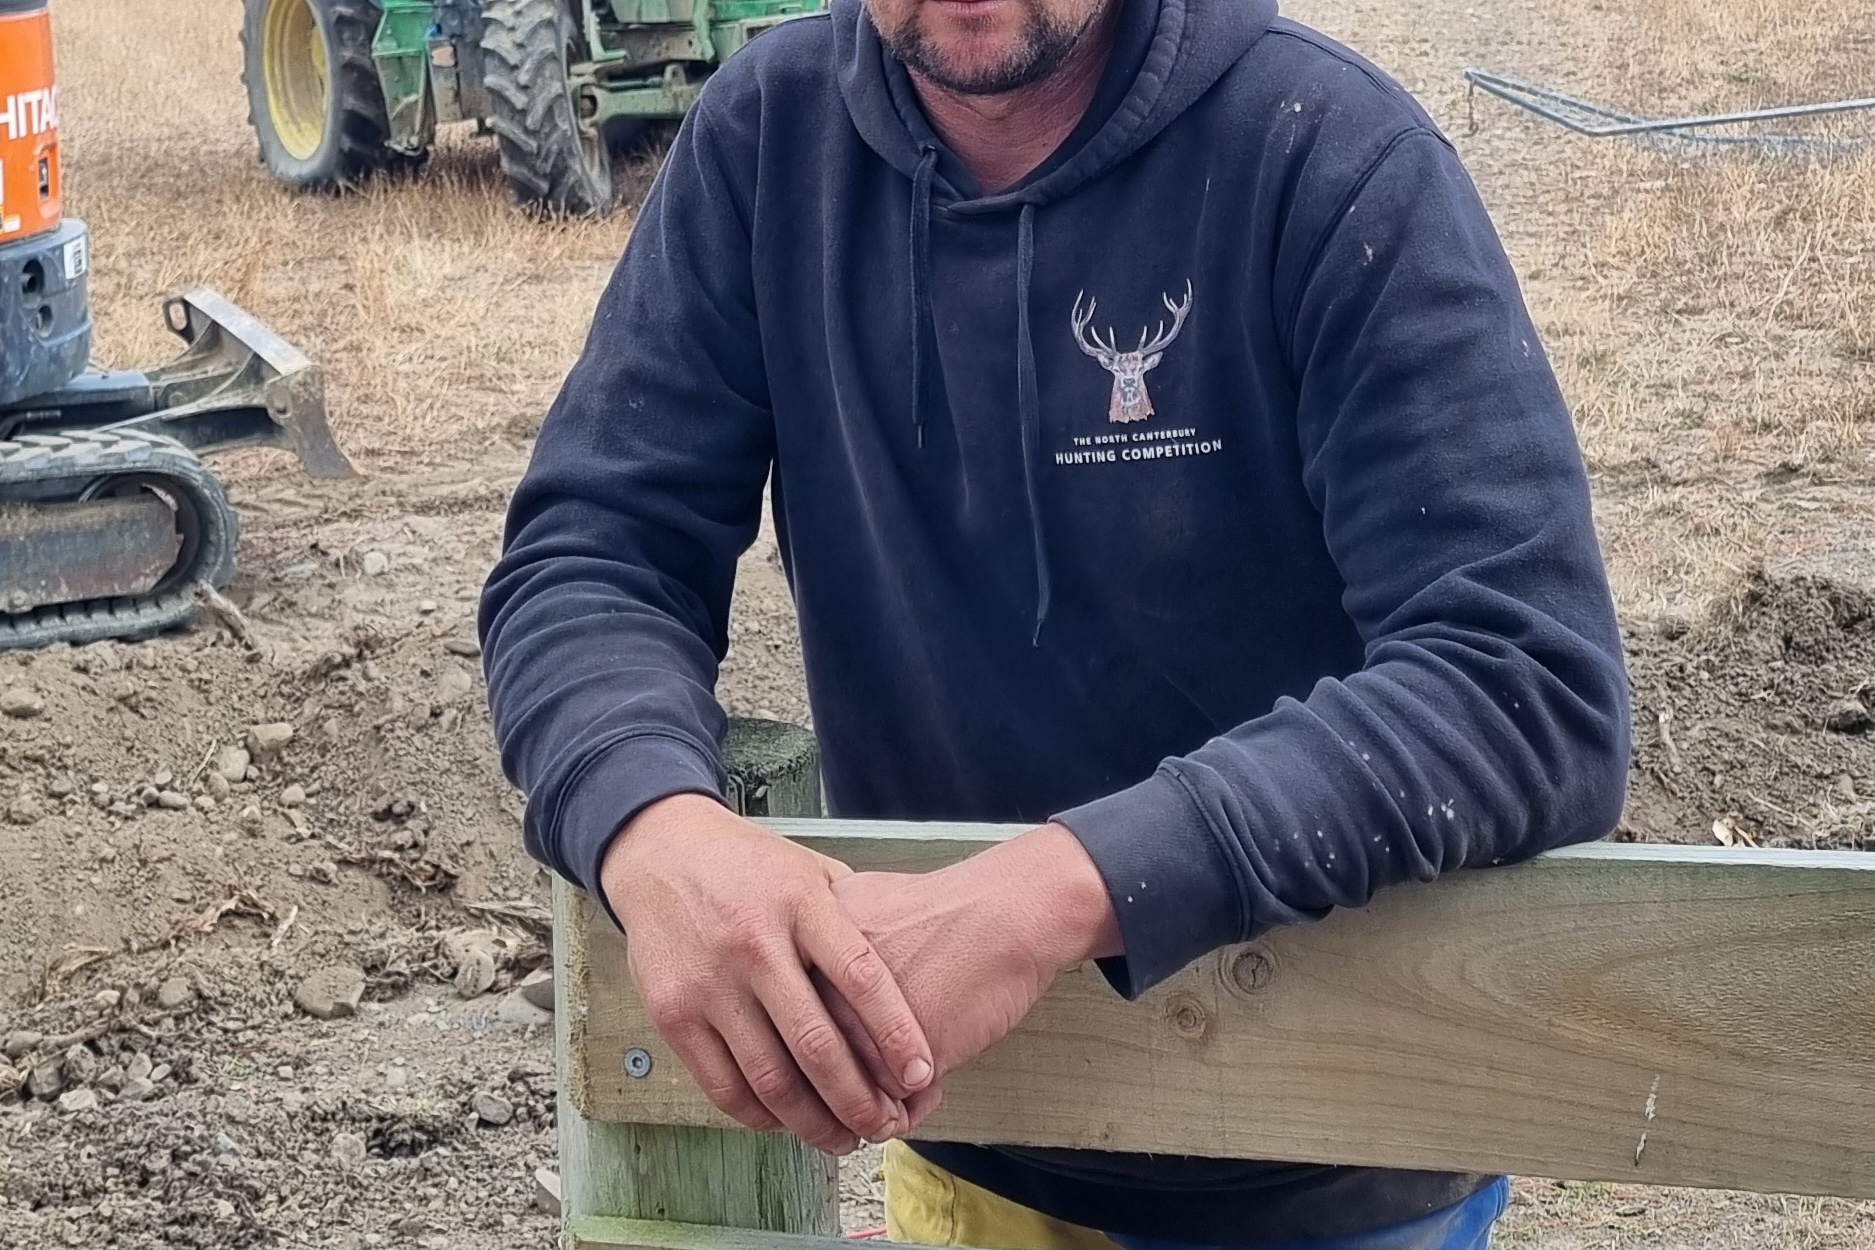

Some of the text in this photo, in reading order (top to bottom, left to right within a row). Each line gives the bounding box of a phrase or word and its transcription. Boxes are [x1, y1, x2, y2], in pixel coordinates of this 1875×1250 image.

[1073, 427, 1196, 447] THE NORTH CANTERBURY
[1055, 438, 1222, 466] HUNTING COMPETITION
